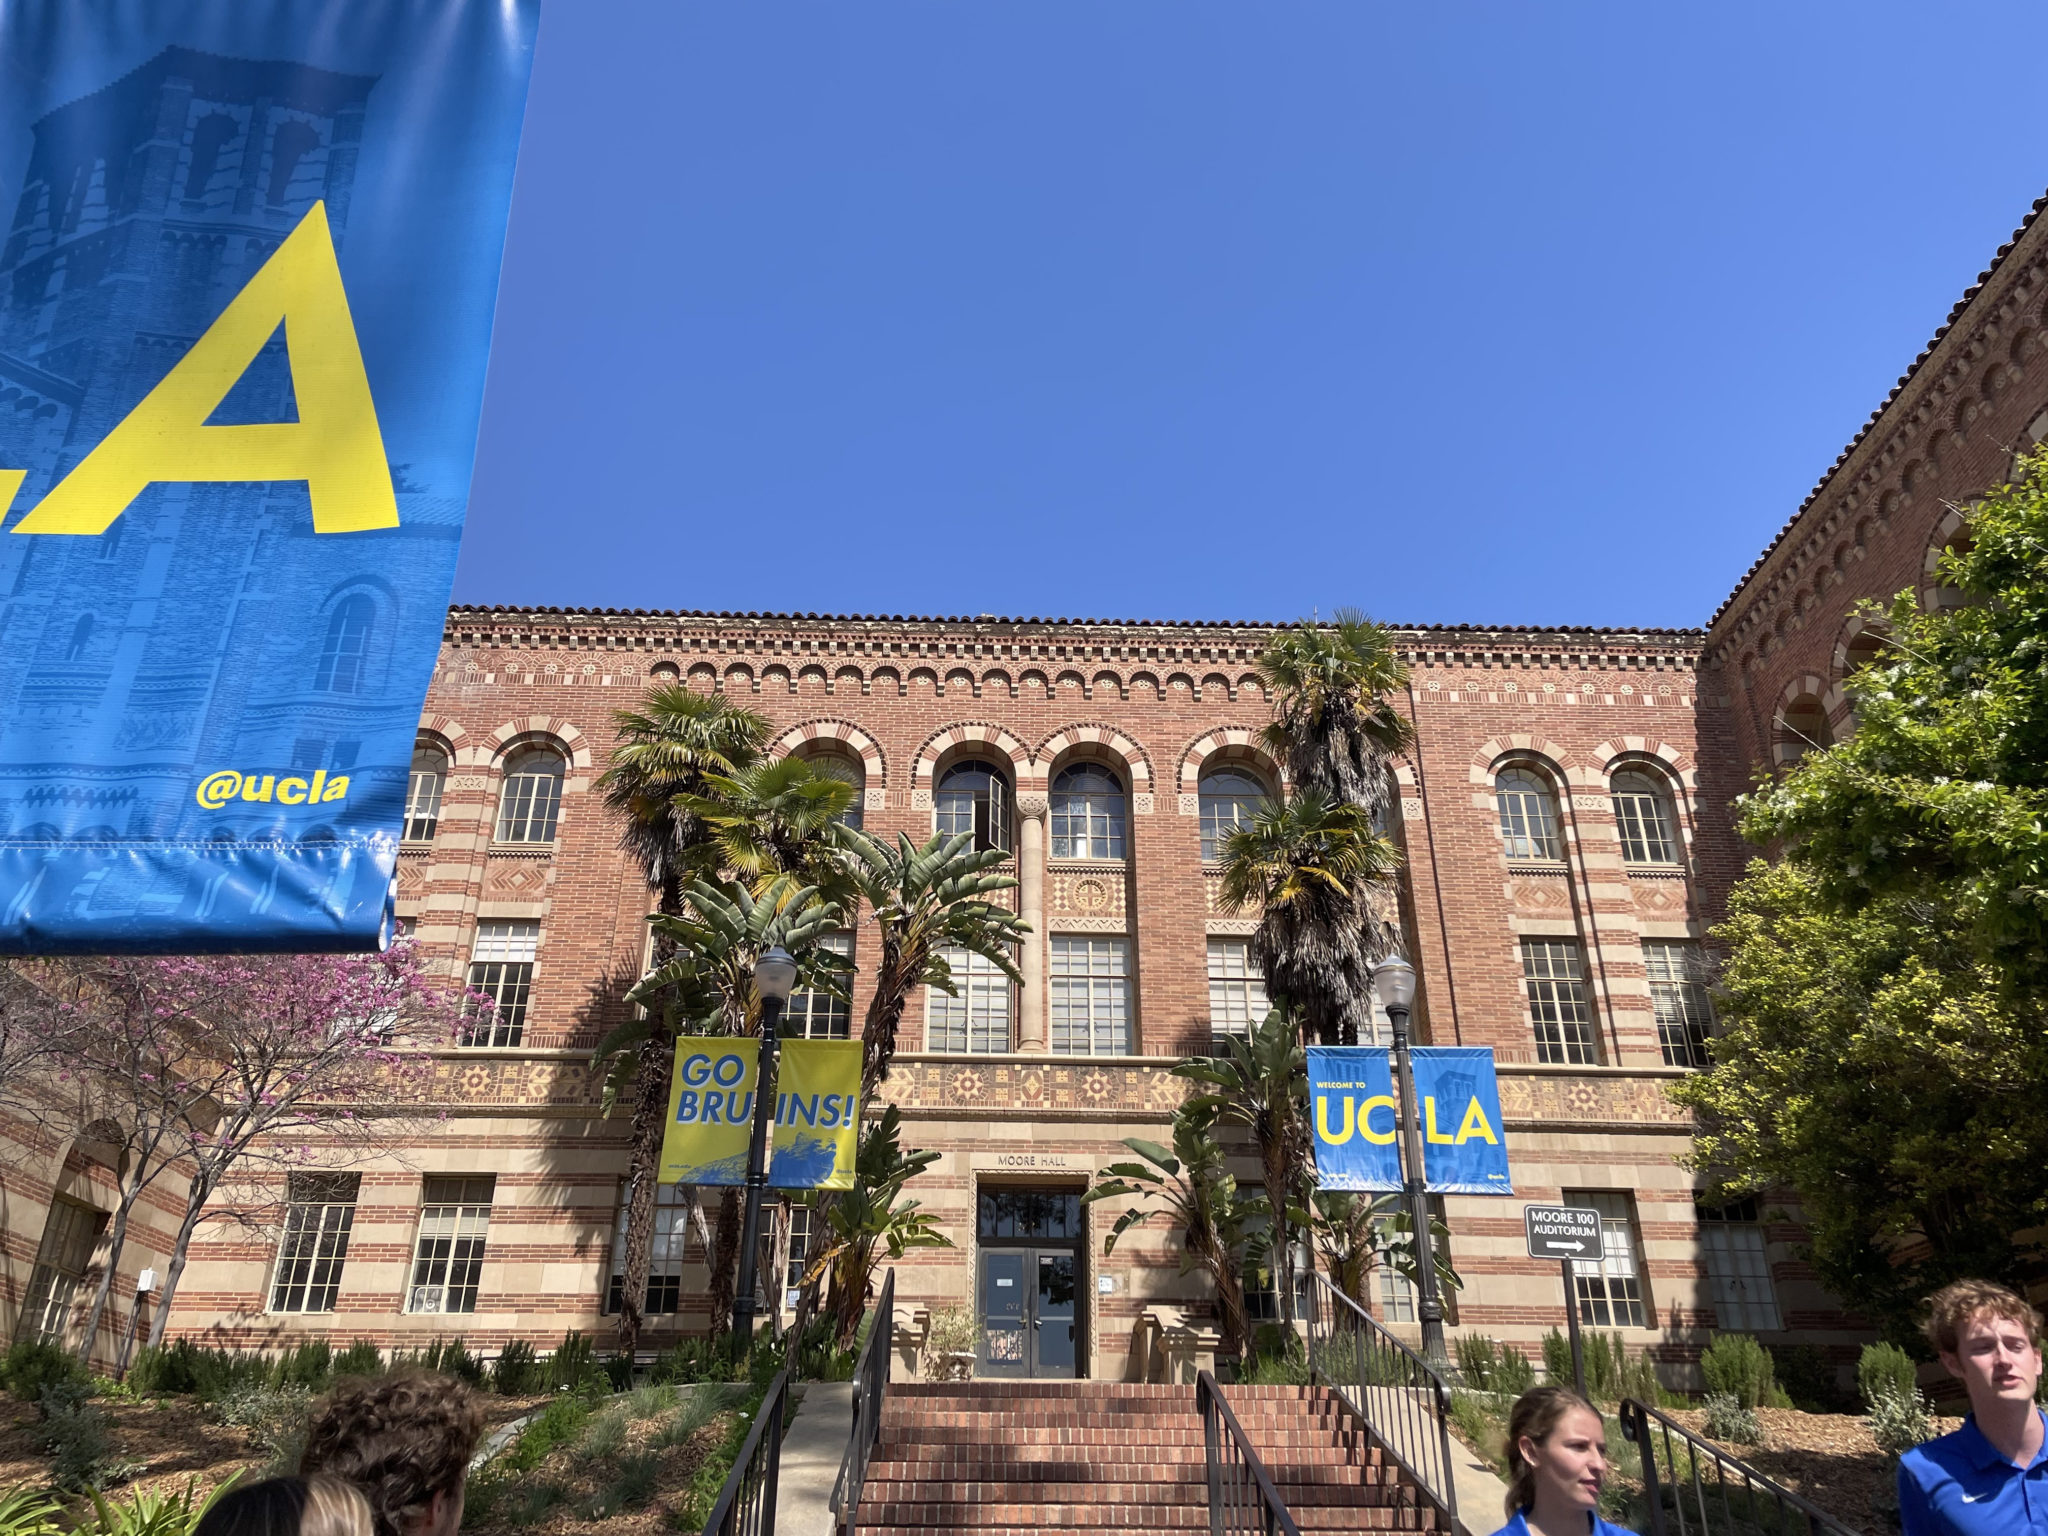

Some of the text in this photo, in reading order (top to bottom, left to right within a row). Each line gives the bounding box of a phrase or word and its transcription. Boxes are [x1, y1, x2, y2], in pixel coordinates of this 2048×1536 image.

[0, 199, 400, 535] A
[196, 769, 351, 810] @ucla
[681, 1053, 745, 1089] GO
[1316, 1081, 1366, 1089] WELCOME TO
[998, 1155, 1066, 1167] MOORE HALL
[1531, 1210, 1595, 1224] MOORE 100
[1533, 1224, 1596, 1237] AUDITORIUM
